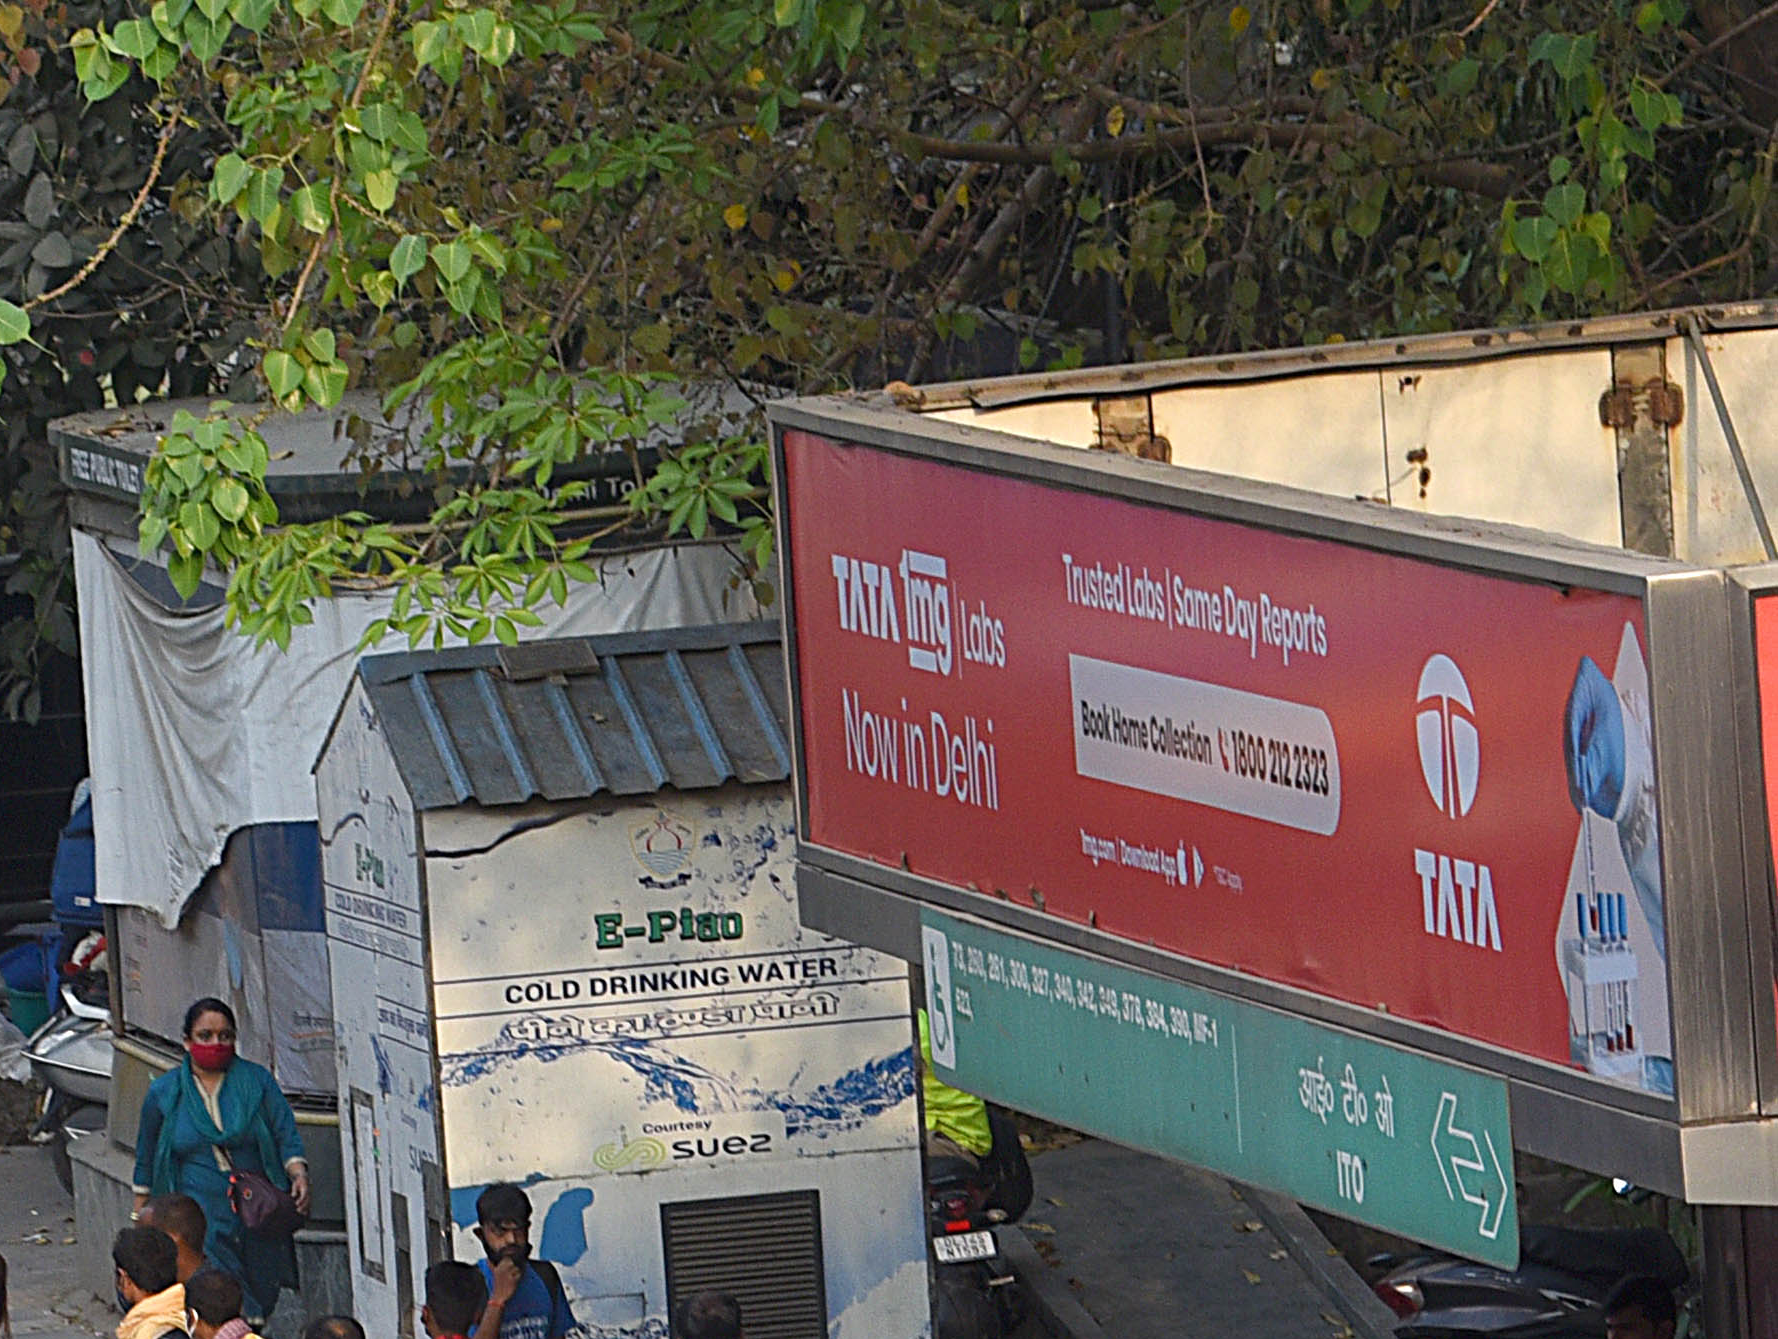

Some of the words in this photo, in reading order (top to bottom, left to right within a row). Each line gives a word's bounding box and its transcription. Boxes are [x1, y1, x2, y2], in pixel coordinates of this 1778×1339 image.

[831, 554, 900, 643] TATA
[898, 548, 952, 676] 1mg
[960, 600, 1006, 668] Labs
[1062, 553, 1125, 613] Trusted
[1126, 566, 1165, 622] Labs
[1174, 575, 1222, 636] Same
[1223, 585, 1258, 659] Day
[1260, 592, 1327, 666] Reports
[842, 687, 898, 784] Now
[901, 697, 929, 792] in
[931, 711, 999, 811] Delhi
[1080, 700, 1112, 742] Book
[1112, 706, 1148, 750] Home
[1150, 716, 1212, 766] Collection
[1232, 730, 1266, 781] 1800
[1269, 737, 1292, 789] 212
[1294, 745, 1330, 797] 2323
[1414, 848, 1503, 952] TATA
[505, 979, 581, 1005] COLD
[589, 965, 730, 998] DRINKING
[737, 957, 838, 984] WATER
[642, 1119, 712, 1135] Courtesy
[1336, 1149, 1365, 1204] ITO
